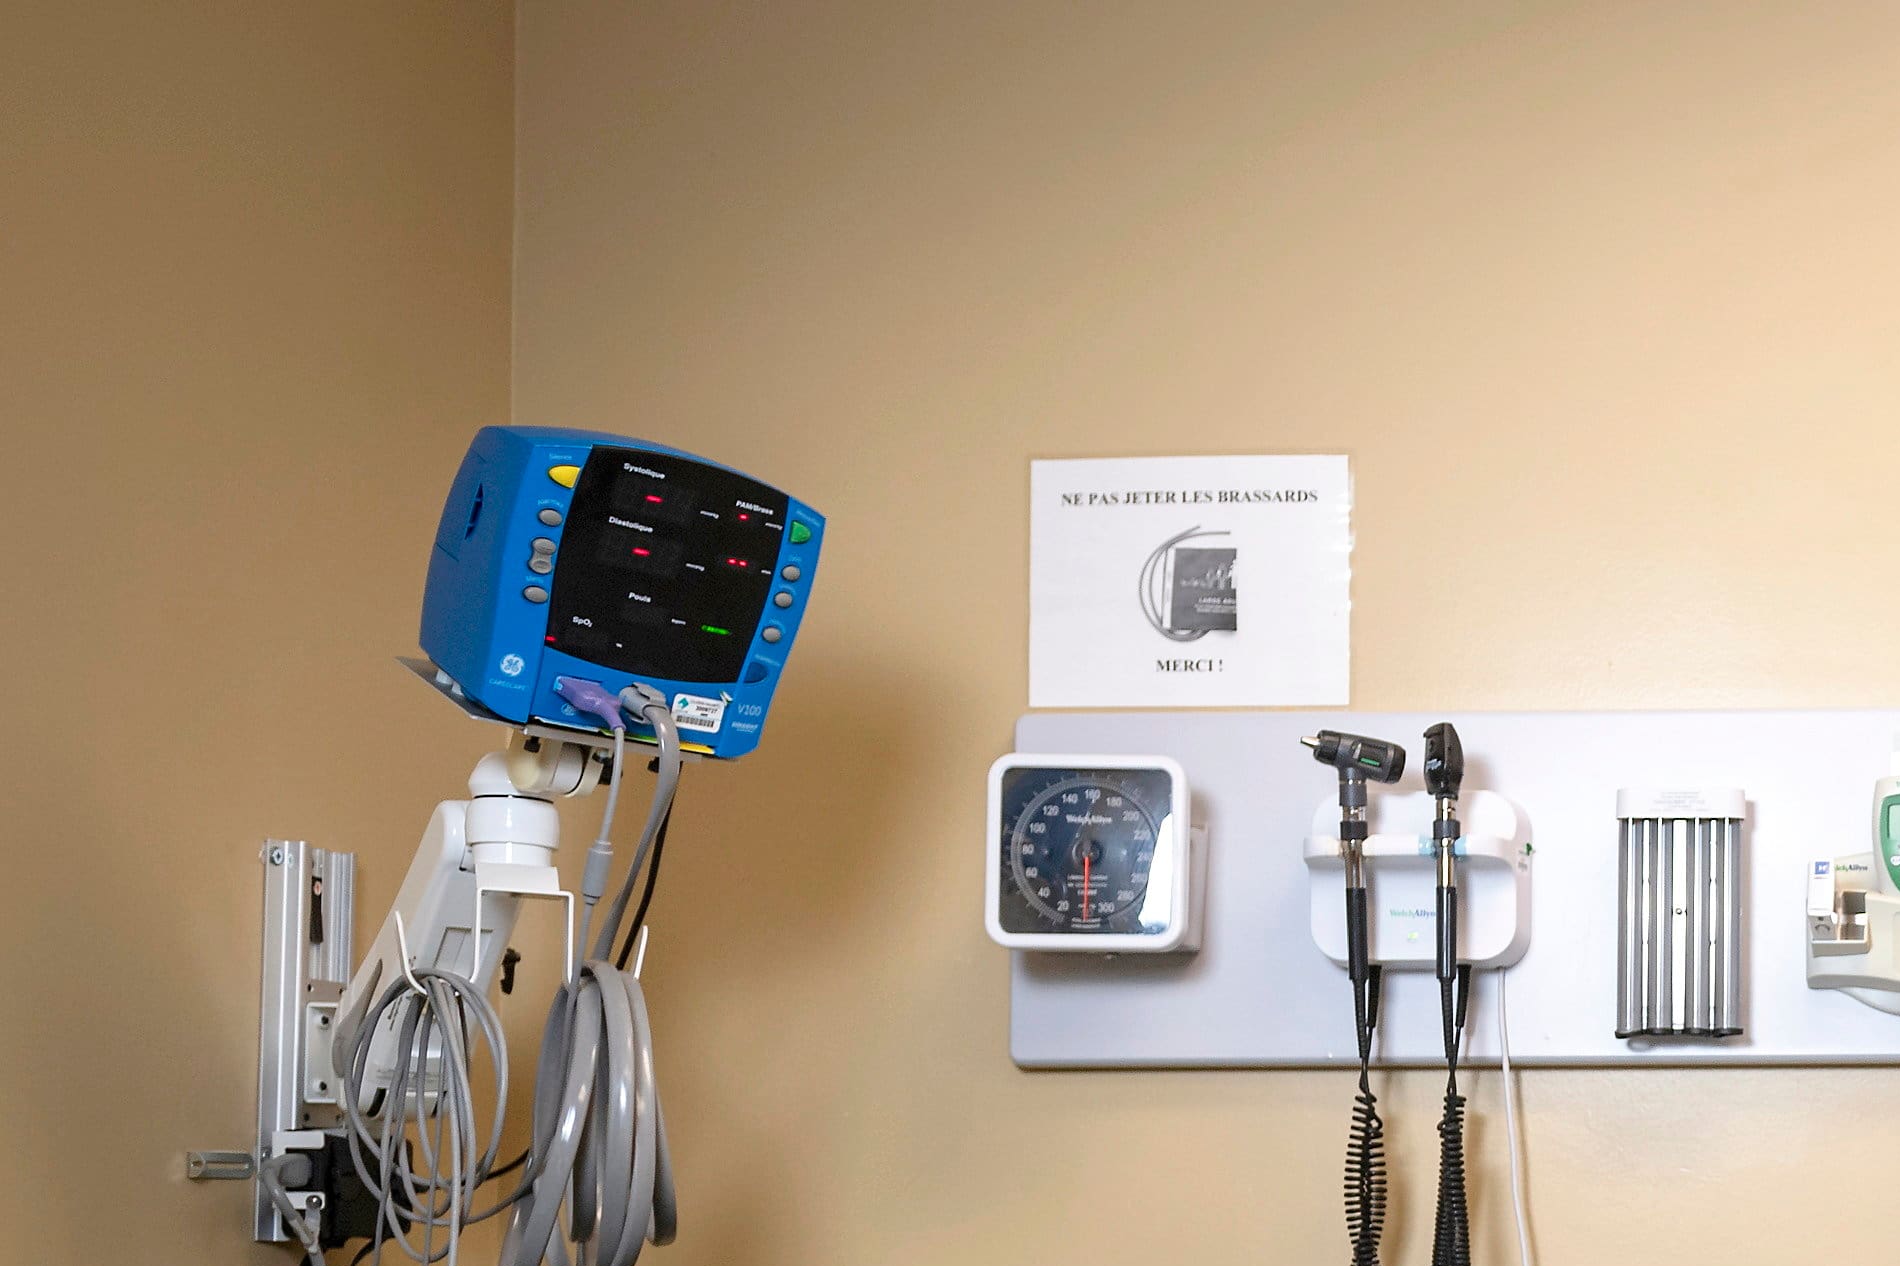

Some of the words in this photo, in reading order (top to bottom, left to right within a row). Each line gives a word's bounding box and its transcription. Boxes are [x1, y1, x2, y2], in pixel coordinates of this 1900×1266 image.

[624, 462, 665, 479] Systolique
[1061, 492, 1083, 506] NE
[1088, 491, 1119, 505] PAS
[1123, 490, 1177, 504] JETER
[1181, 489, 1213, 503] LES
[1218, 489, 1318, 503] BRASSARDS
[608, 516, 653, 533] Diastolique
[628, 591, 651, 603] Pouls
[1156, 659, 1213, 672] MERCI
[1038, 886, 1050, 899] 40
[1057, 900, 1070, 911] 20
